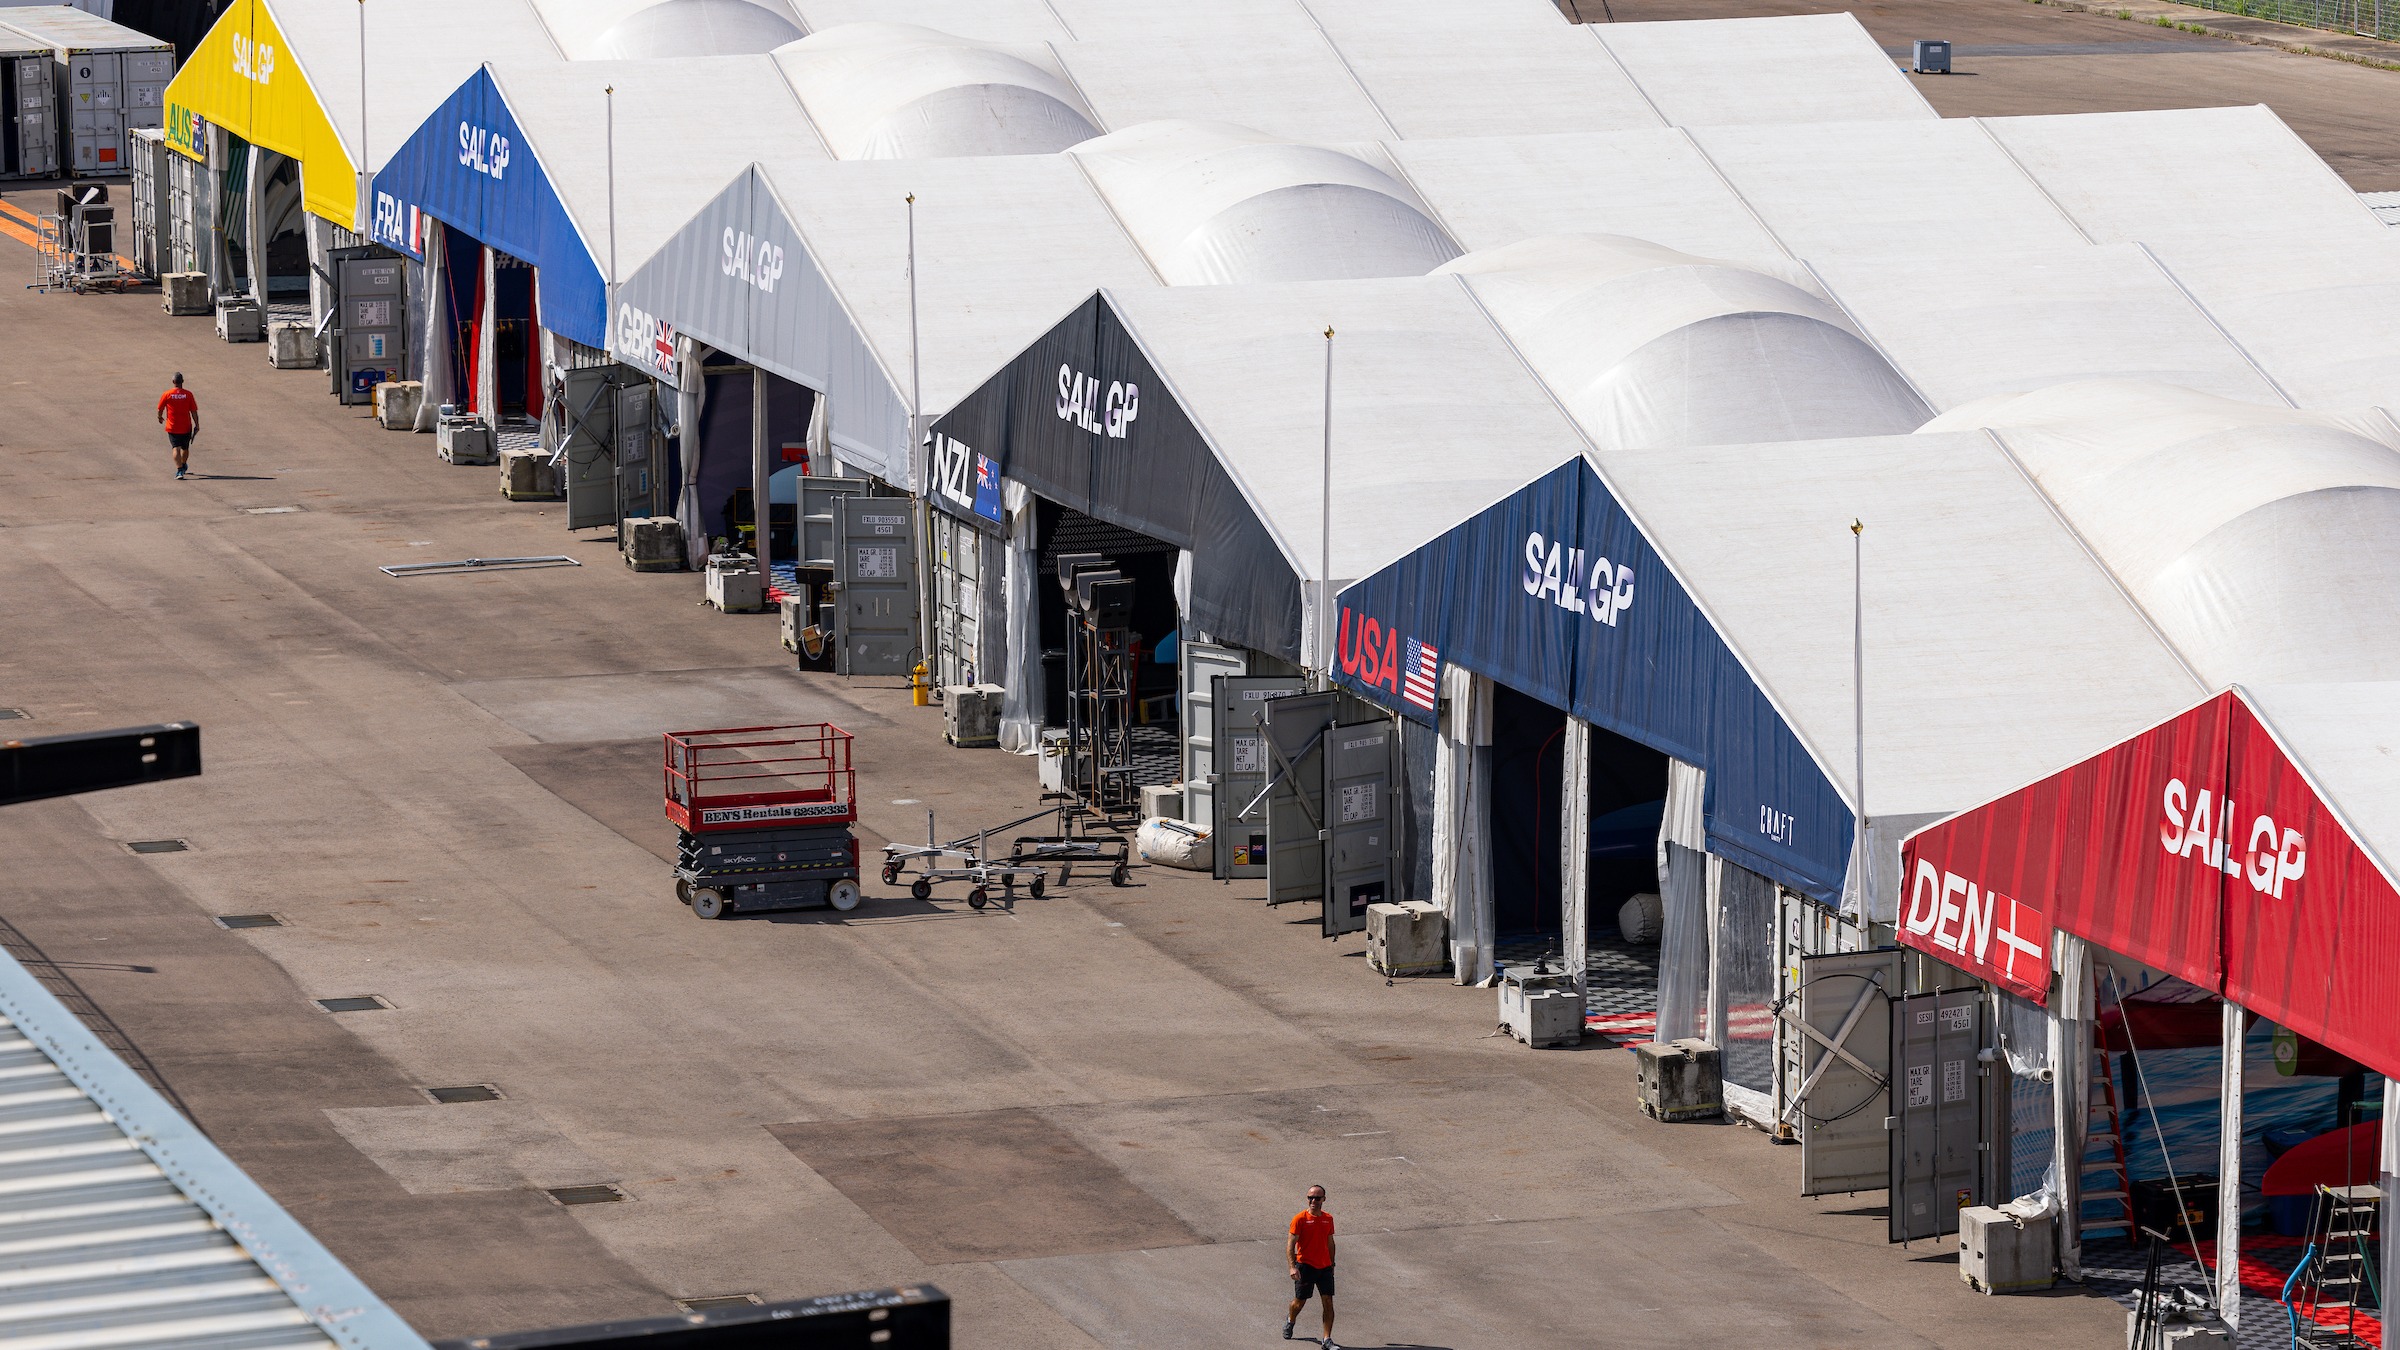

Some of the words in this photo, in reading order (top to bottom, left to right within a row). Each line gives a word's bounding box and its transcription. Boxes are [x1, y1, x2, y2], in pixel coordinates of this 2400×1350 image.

[167, 102, 191, 149] AUS
[374, 191, 404, 246] FRA
[617, 302, 655, 366] GBR
[932, 432, 973, 510] NZL
[1338, 606, 1398, 695] USA
[704, 810, 741, 822] BEN'S
[743, 807, 792, 819] Rentals
[1760, 804, 1794, 846] CRAFT
[1905, 858, 1996, 965] DEN
[1918, 1012, 1933, 1023] SESU
[1940, 1008, 1963, 1020] 492421
[1953, 1019, 1969, 1029] 45G1
[1910, 1077, 1922, 1086] TARE
[1910, 1087, 1919, 1096] NET
